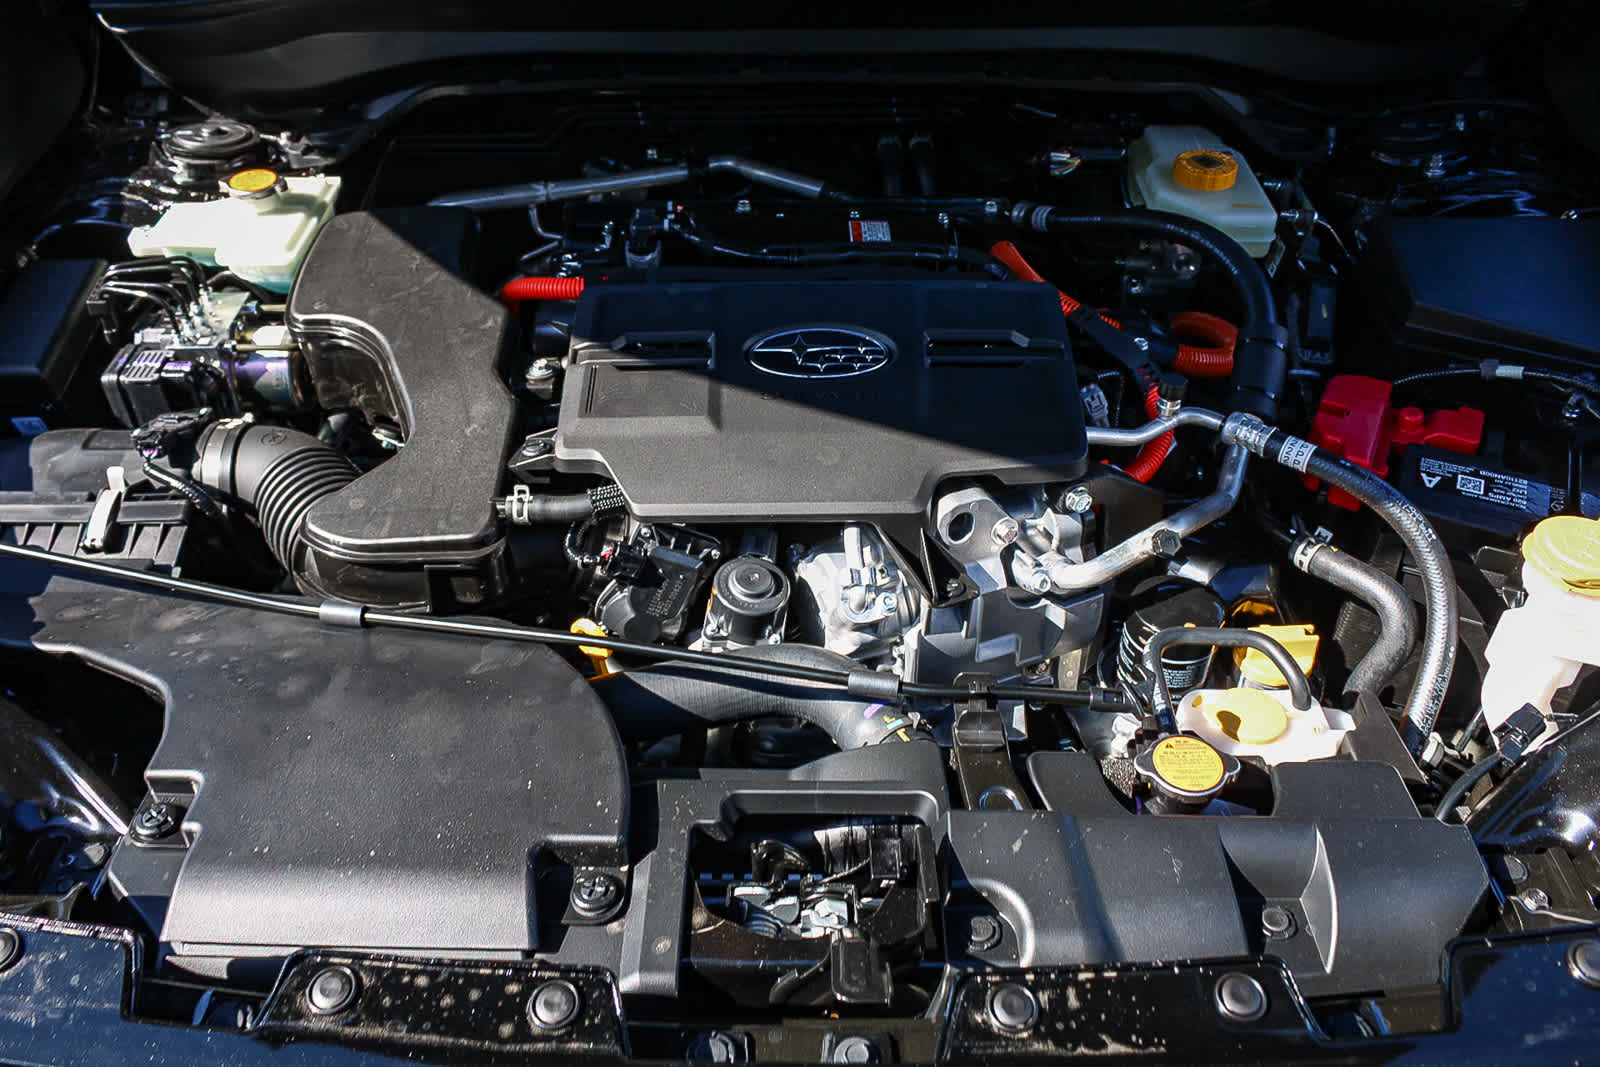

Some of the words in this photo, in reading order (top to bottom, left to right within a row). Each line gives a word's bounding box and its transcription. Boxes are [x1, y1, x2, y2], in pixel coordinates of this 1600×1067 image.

[1286, 447, 1293, 456] 2
[1295, 450, 1304, 458] P
[1420, 472, 1442, 488] A
